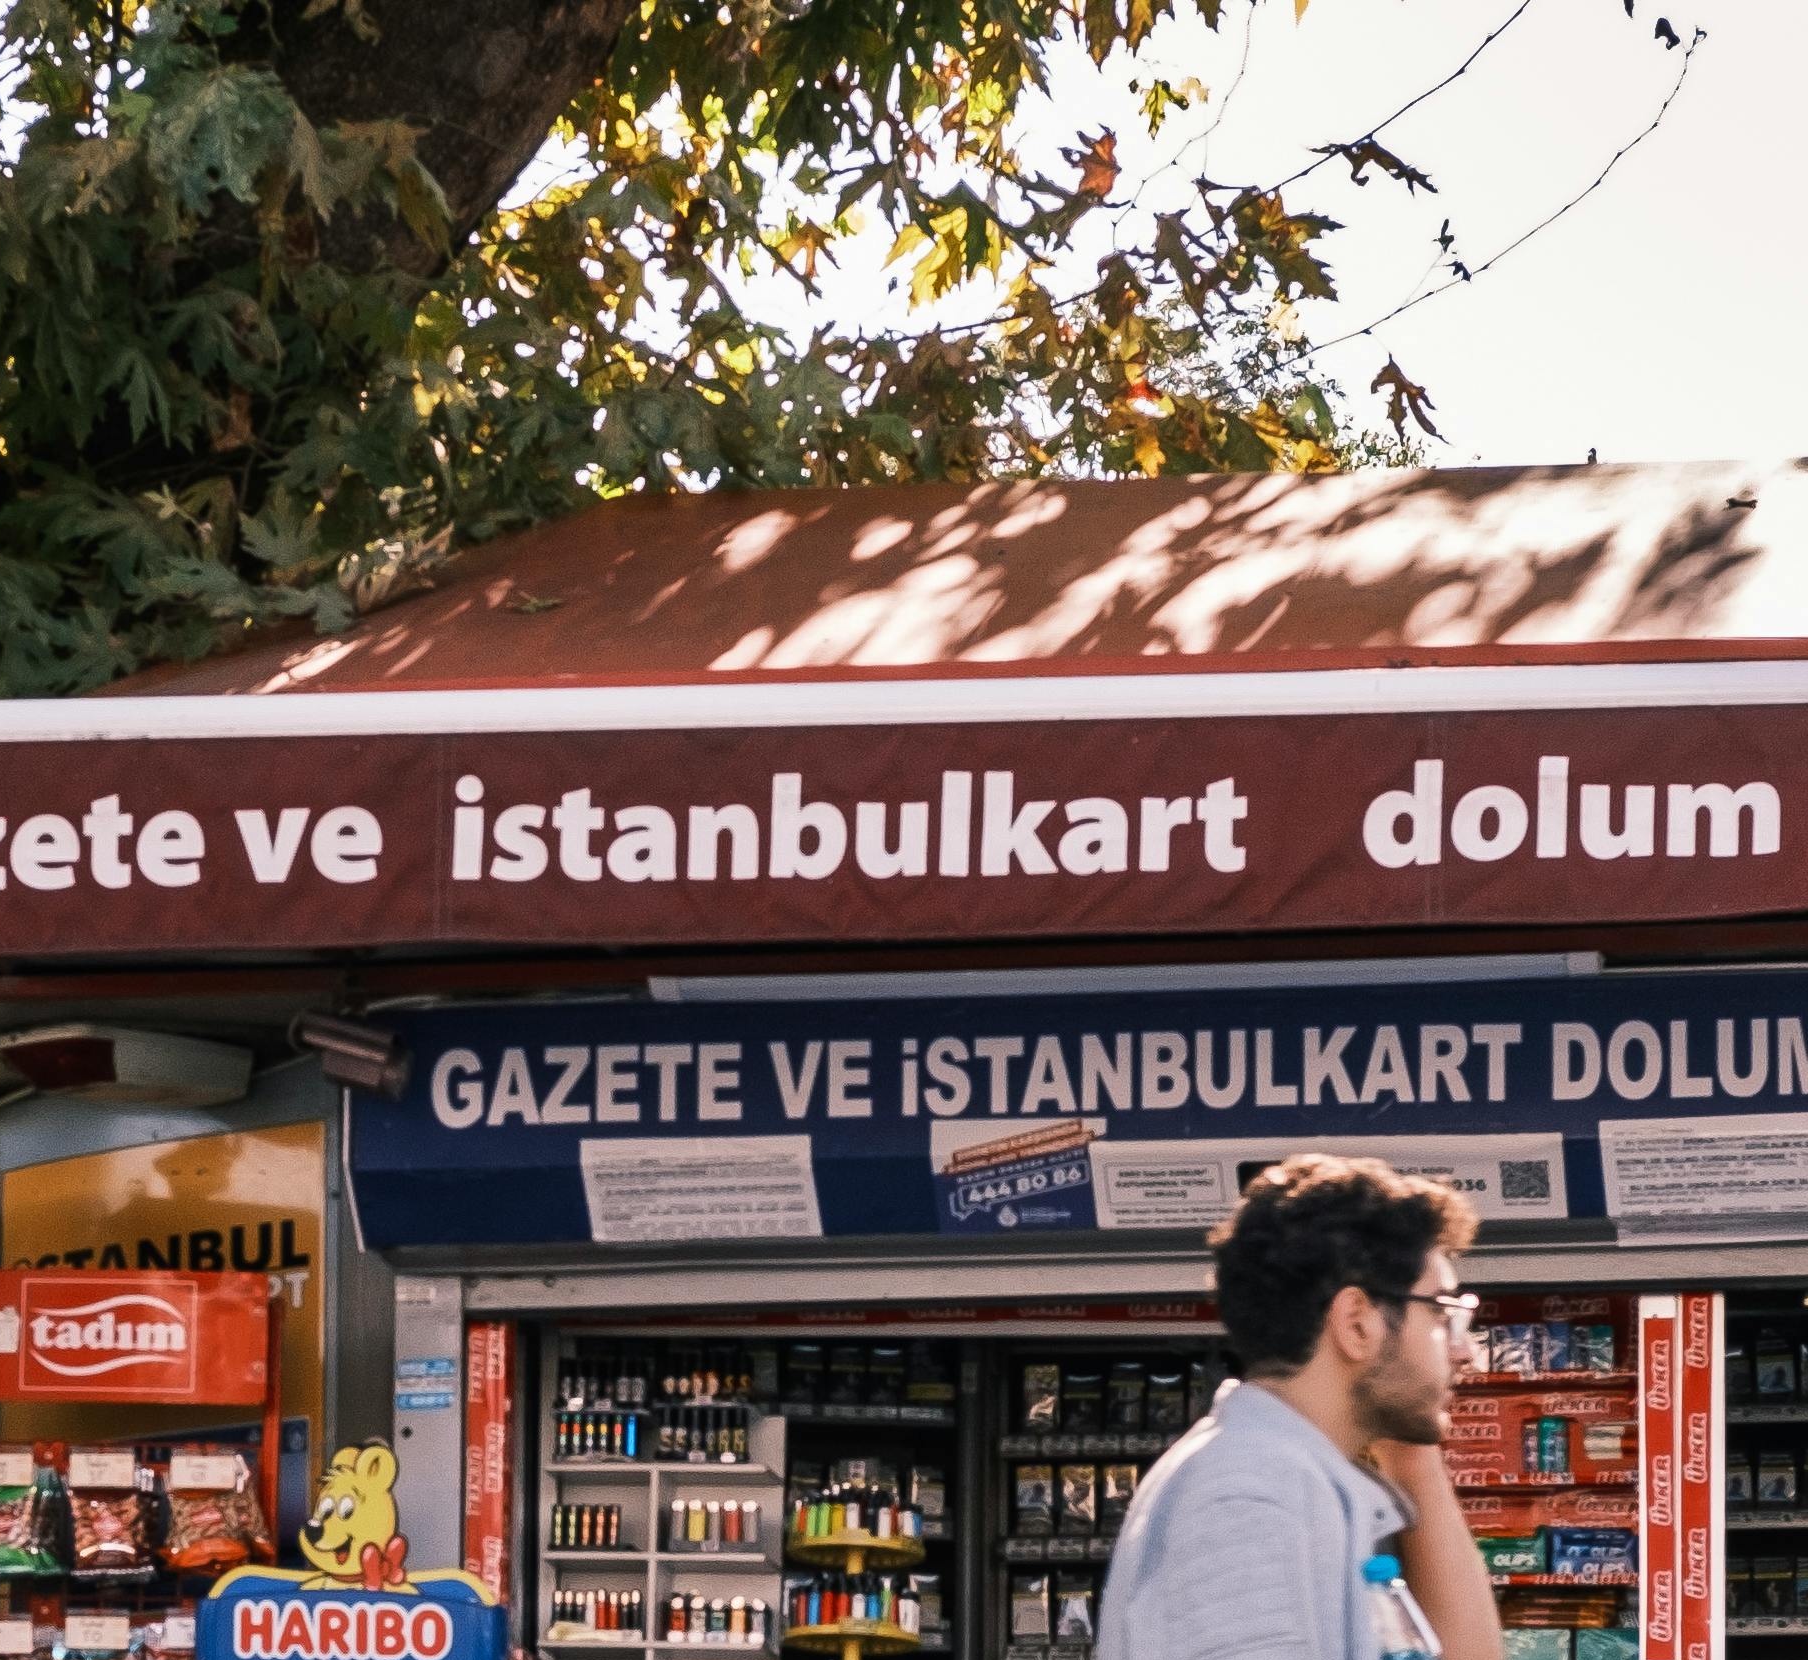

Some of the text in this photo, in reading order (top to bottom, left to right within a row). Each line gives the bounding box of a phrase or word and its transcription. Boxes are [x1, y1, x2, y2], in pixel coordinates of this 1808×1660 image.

[236, 803, 383, 883] ve
[452, 770, 1250, 882] istanbulkart
[1363, 756, 1782, 867] dolum
[432, 1044, 742, 1127] GAZETE
[777, 1037, 873, 1119] VE
[968, 1165, 1083, 1203] 444 80 86
[30, 1312, 187, 1352] tadım
[235, 1602, 451, 1660] HARIBO
